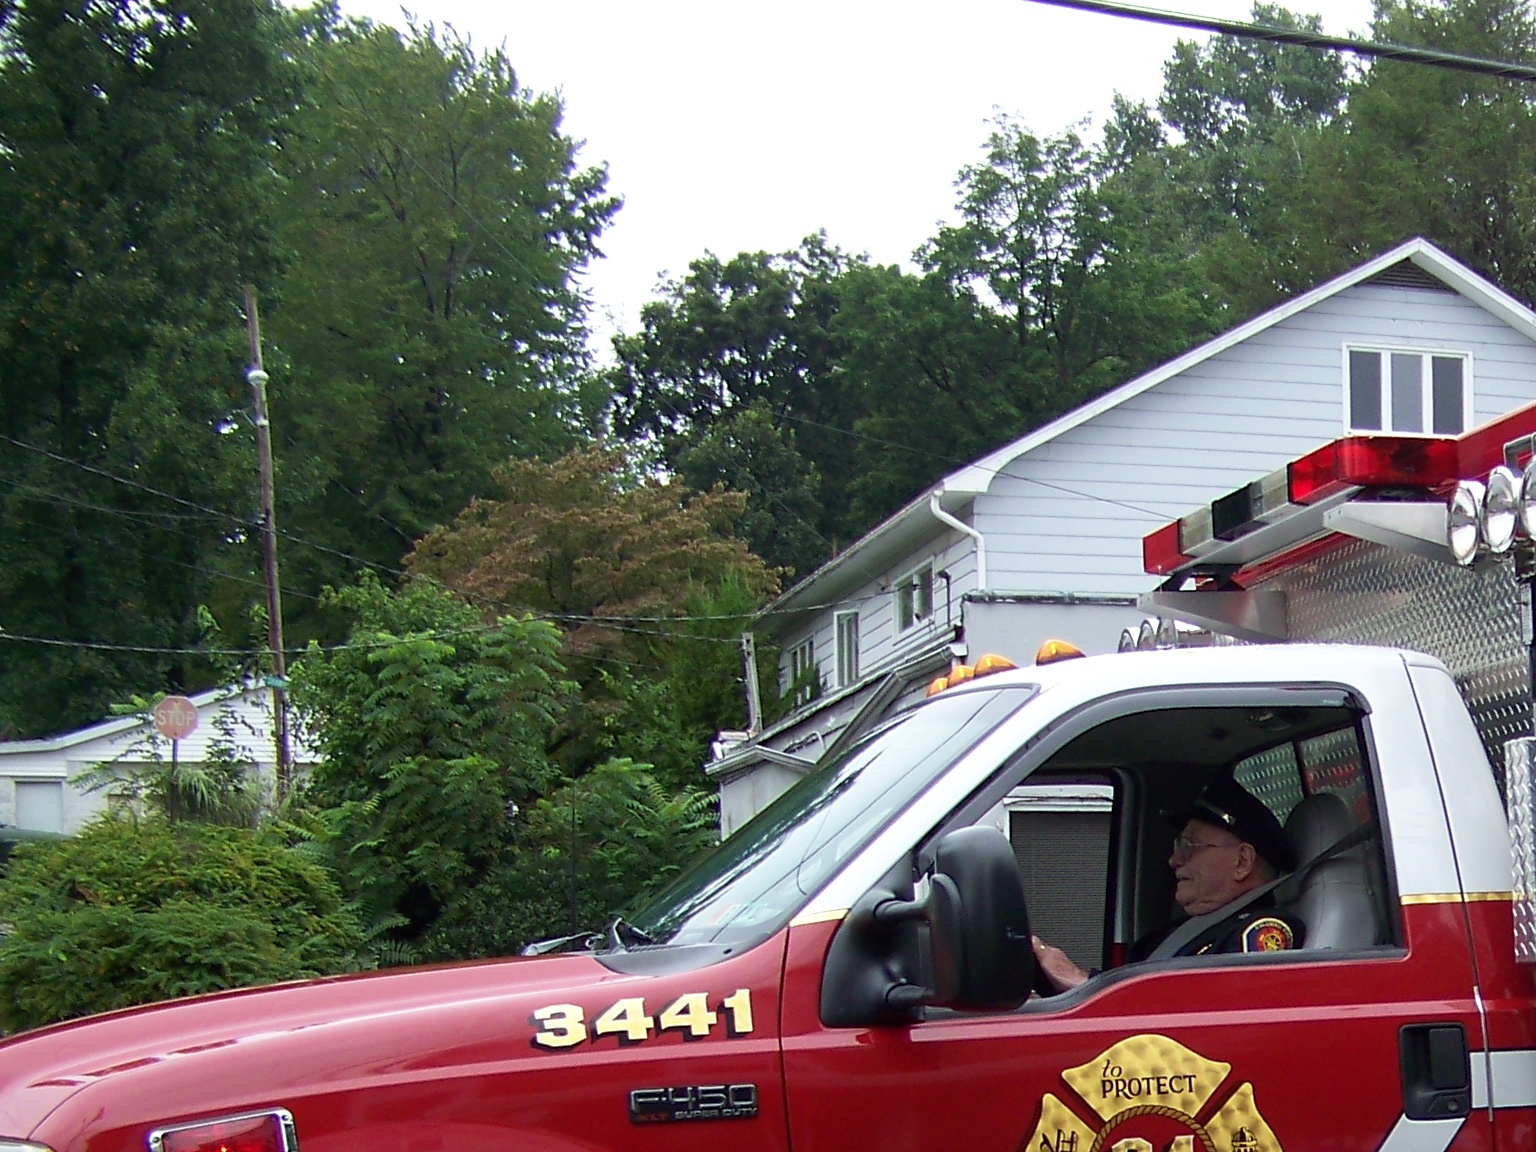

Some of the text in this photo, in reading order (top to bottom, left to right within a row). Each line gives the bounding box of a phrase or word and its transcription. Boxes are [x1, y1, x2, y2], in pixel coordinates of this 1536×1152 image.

[157, 711, 195, 726] STOP
[531, 988, 754, 1048] 3441
[1101, 1058, 1123, 1079] to
[1101, 1075, 1196, 1099] PROTECT
[674, 1109, 720, 1120] SUPER
